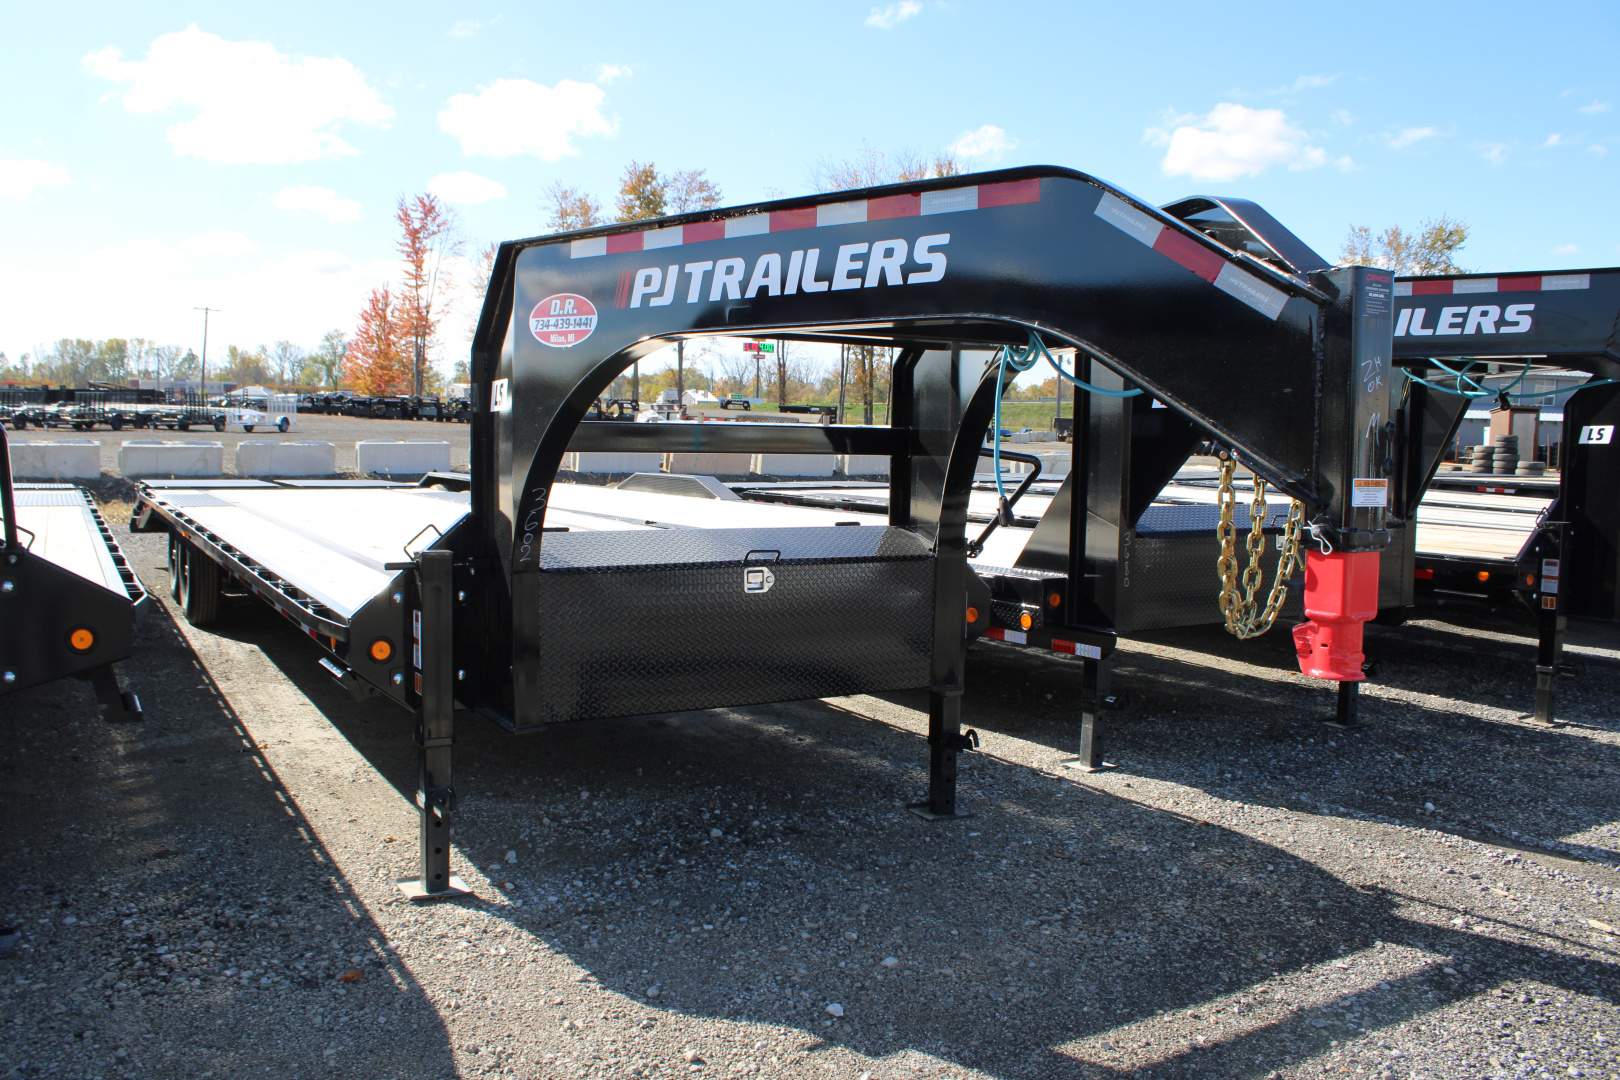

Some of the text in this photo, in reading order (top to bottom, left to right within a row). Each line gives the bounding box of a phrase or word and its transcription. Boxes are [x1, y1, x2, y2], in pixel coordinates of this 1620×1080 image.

[1366, 274, 1391, 283] DEMCO
[549, 298, 578, 316] D.R.
[534, 316, 593, 330] 734-439-1441
[494, 383, 504, 406] LS
[1587, 427, 1606, 441] LS
